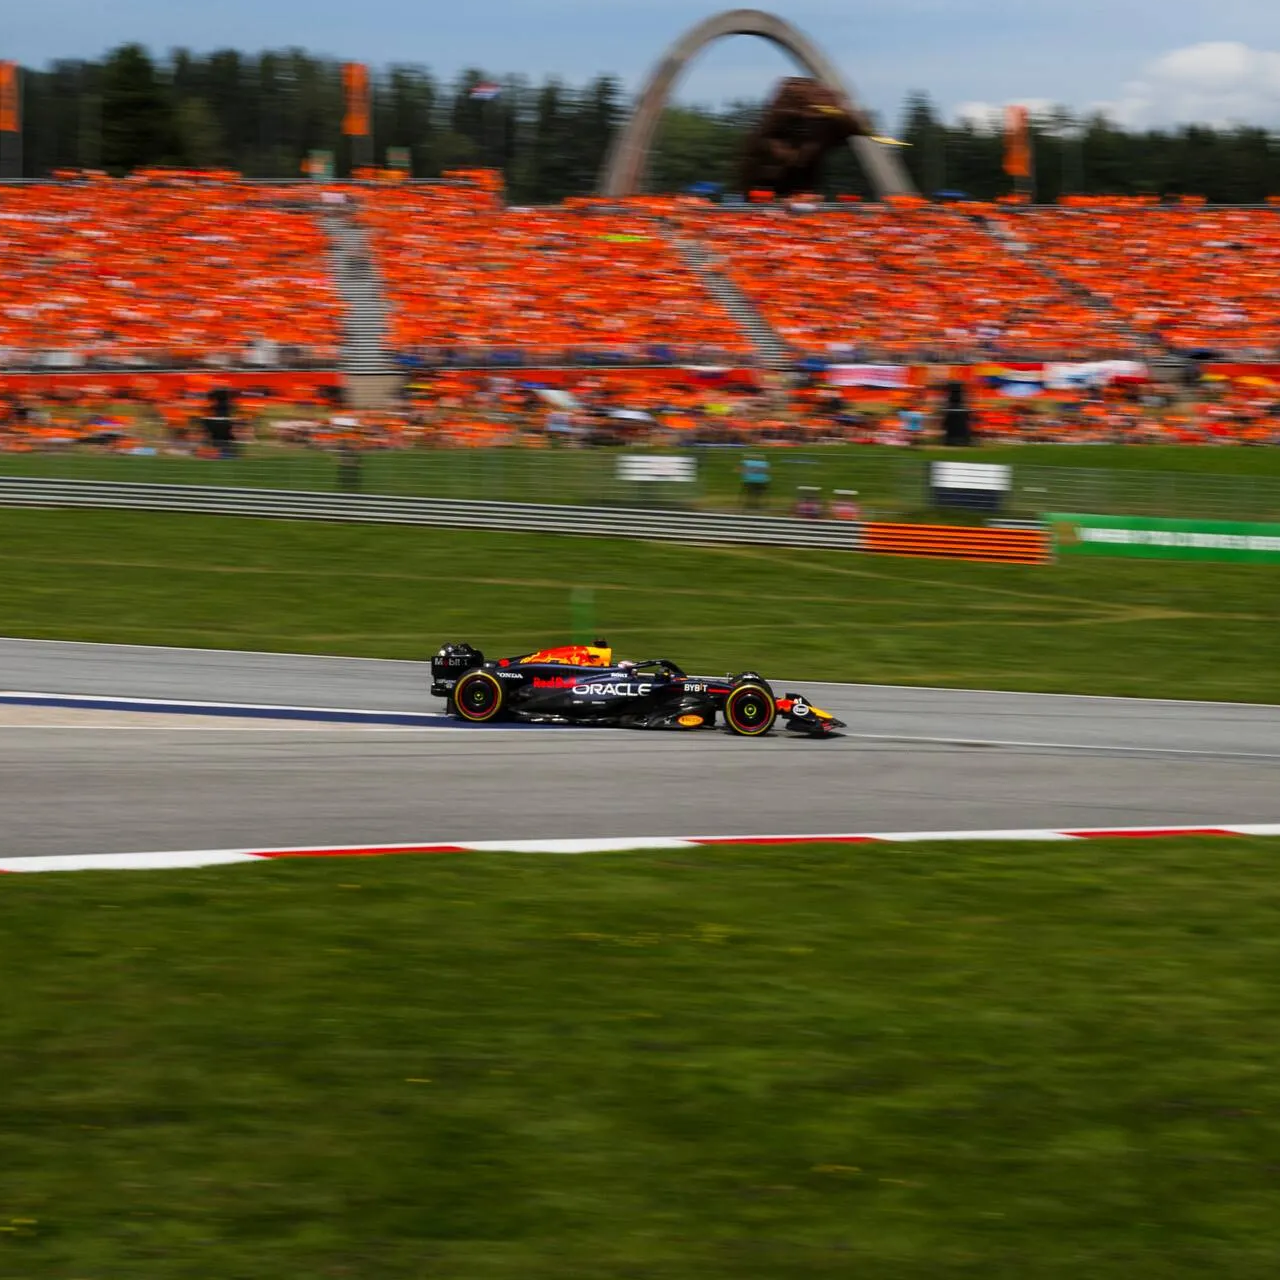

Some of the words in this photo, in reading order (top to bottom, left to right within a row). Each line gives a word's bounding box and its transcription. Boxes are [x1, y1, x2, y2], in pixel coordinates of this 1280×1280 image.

[497, 671, 523, 679] ONDA
[533, 675, 554, 688] Red
[572, 683, 652, 697] ORACLE
[684, 683, 708, 692] BYBIT
